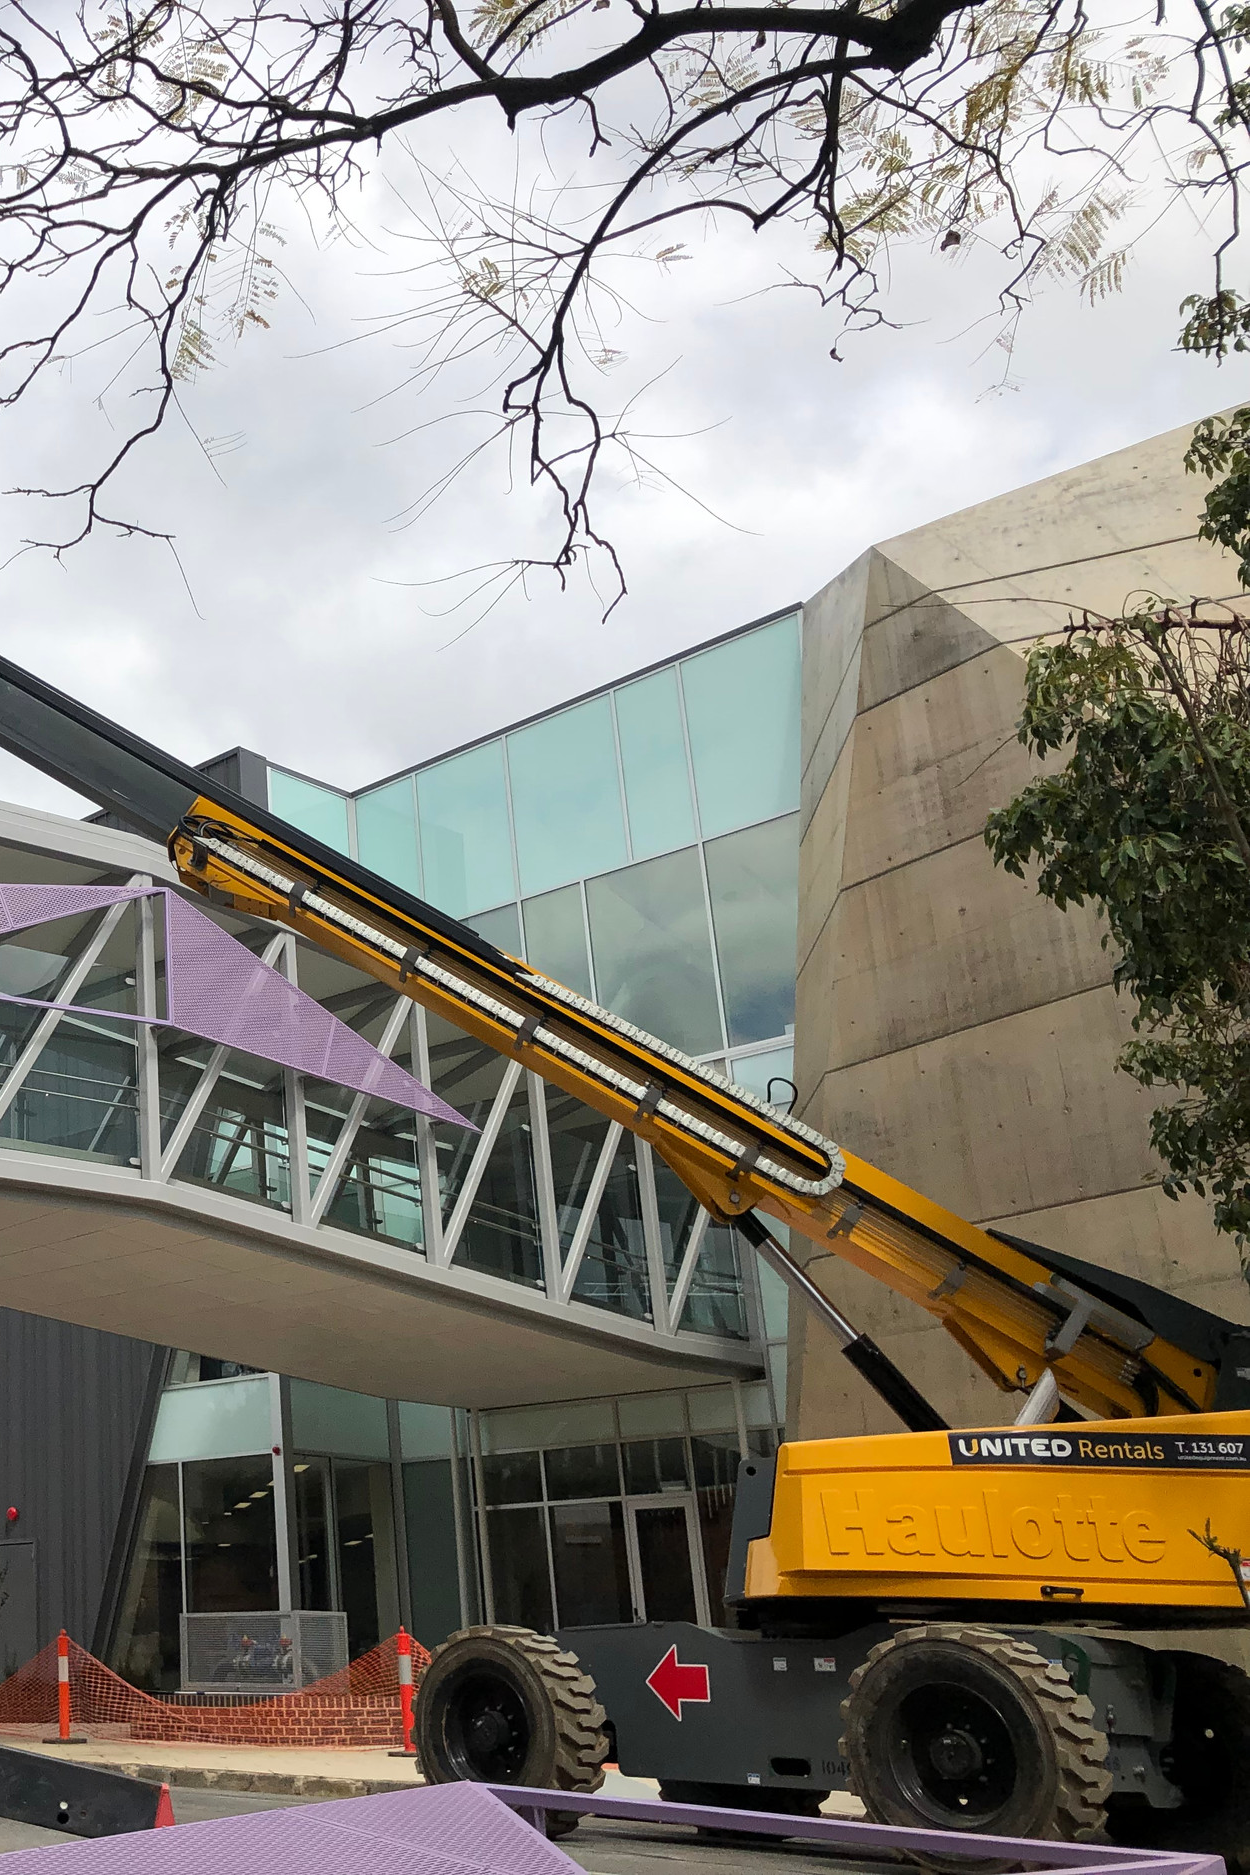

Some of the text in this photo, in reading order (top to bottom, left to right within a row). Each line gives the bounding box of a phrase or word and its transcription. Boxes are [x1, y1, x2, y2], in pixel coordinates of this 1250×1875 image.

[958, 1438, 1244, 1460] UNITED Rentals T. 131 607
[819, 1488, 1166, 1564] Haulotte
